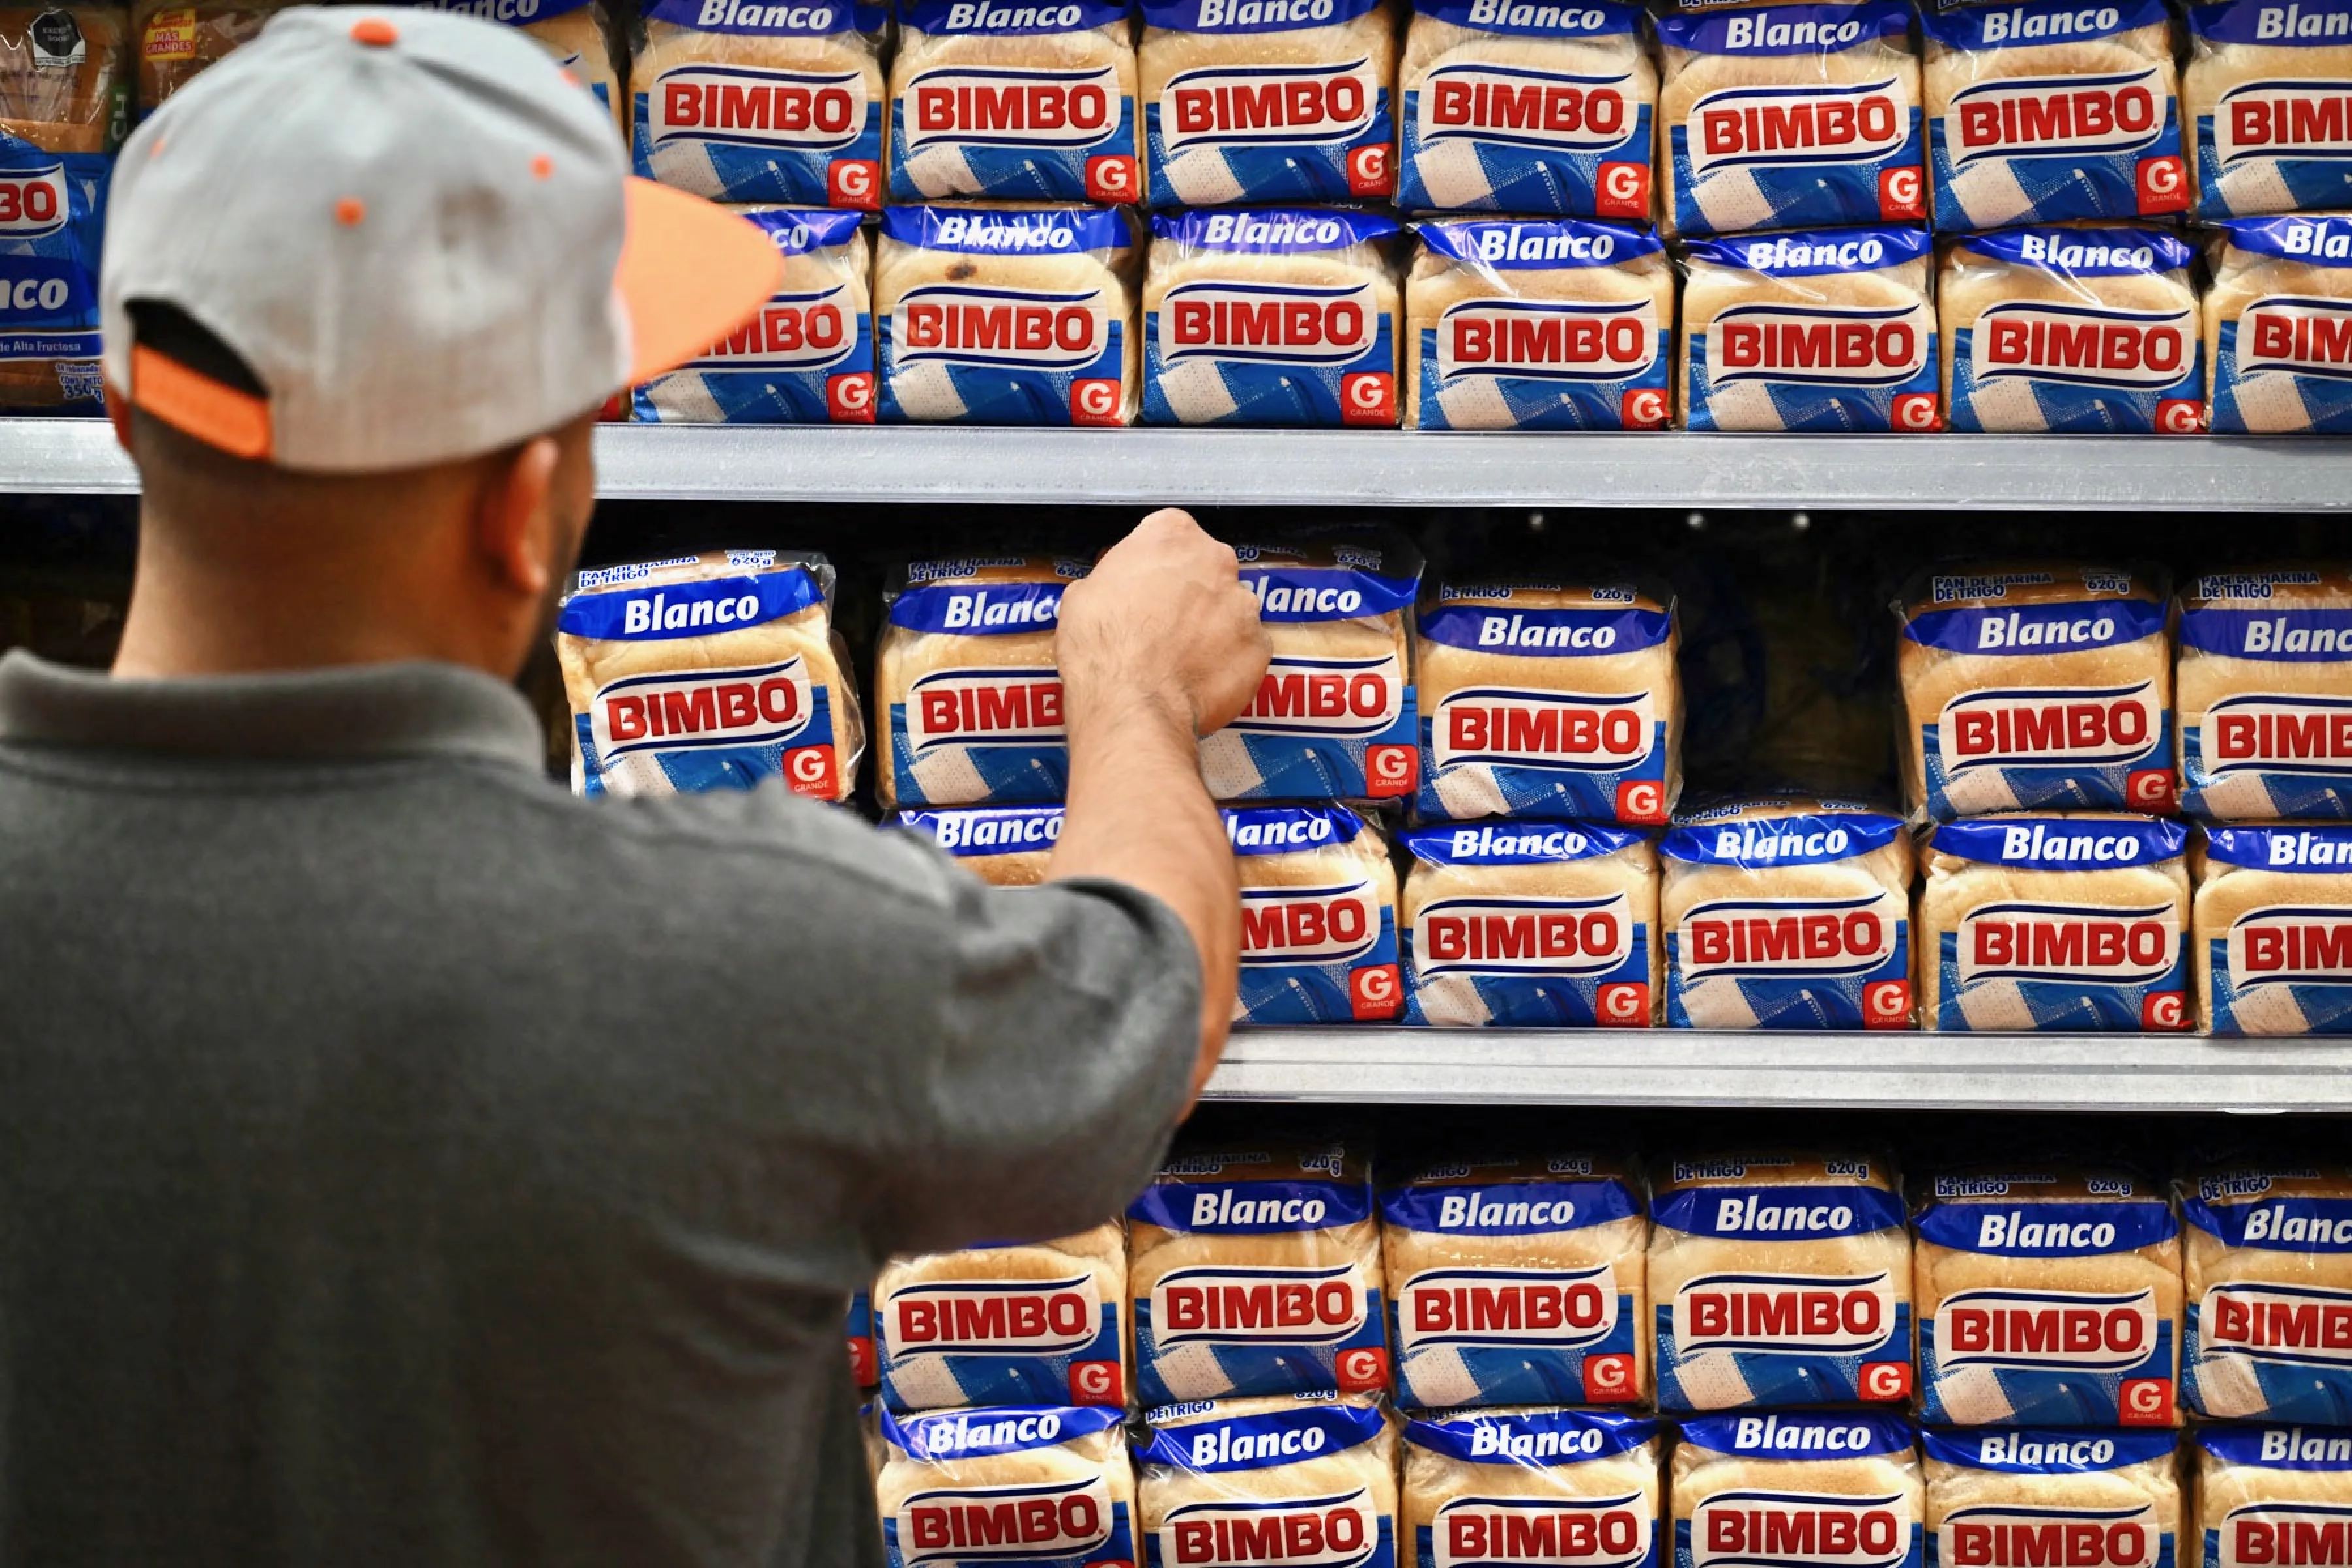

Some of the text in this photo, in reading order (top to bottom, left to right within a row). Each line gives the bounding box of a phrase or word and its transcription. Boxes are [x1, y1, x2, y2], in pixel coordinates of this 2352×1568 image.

[698, 0, 832, 30] Blanco
[946, 0, 1081, 29] Blanco
[1197, 0, 1333, 27] Blanco
[1468, 0, 1605, 31] Blanco
[1726, 12, 1860, 49] Blanco
[1982, 7, 2119, 43] Blanco
[2256, 3, 2352, 39] Blan
[146, 41, 192, 53] GRANDES
[665, 83, 853, 133] BIMBO
[918, 84, 1106, 130] BIMBO
[1176, 77, 1364, 133] BIMBO
[1433, 81, 1624, 133] BIMBO
[1960, 86, 2153, 146] BIMBO
[2232, 97, 2343, 144] BIM
[1704, 96, 1895, 154] BIMBO
[838, 163, 869, 196] G
[1096, 159, 1127, 189] G
[1356, 148, 1384, 179] G
[2147, 161, 2178, 192] G
[1607, 166, 1639, 199] G
[1889, 170, 1918, 203] G
[1604, 199, 1639, 208] GRANDE
[937, 216, 1074, 248] Blanco
[1203, 213, 1341, 244] Blanco
[1479, 229, 1614, 261] Blanco
[2284, 225, 2352, 256] Bla
[1747, 238, 1882, 270] Blanco
[2021, 234, 2155, 269] Blanco
[699, 304, 843, 357] MBO
[907, 304, 1093, 351] BIMBO
[1174, 301, 1363, 346] BIMBO
[1454, 318, 1644, 362] BIMBO
[2254, 314, 2352, 361] BIM
[13, 340, 81, 351] Alta Fructosa
[1723, 321, 1914, 367] BIMBO
[1989, 319, 2182, 371] BIMBO
[838, 376, 869, 409] G
[1081, 382, 1113, 414] G
[1351, 376, 1384, 408] G
[1903, 397, 1934, 427] G
[2166, 402, 2196, 433] G
[928, 566, 977, 578] TRIGO
[1935, 573, 2053, 588] PAN DE HARINA
[2200, 575, 2232, 586] PAN
[2259, 572, 2319, 584] HARINA
[1935, 585, 2005, 602] DE TRIGO
[2201, 583, 2272, 598] DE TRIGO
[624, 593, 760, 634] Blanco
[944, 591, 1060, 628] Blanc
[1478, 615, 1616, 649] Blanco
[1978, 613, 2116, 649] Blanco
[2244, 617, 2352, 653] Blanc
[607, 677, 797, 740] BIMBO
[921, 683, 1065, 734] BIMB
[1240, 672, 1387, 717] MBO
[1450, 707, 1642, 754] BIMBO
[1955, 700, 2151, 755] BIMBO
[2217, 714, 2352, 759] BIM
[793, 750, 825, 781] G
[1376, 749, 1407, 779] G
[794, 780, 829, 792] GRANDE
[1627, 785, 1657, 815] G
[2137, 773, 2166, 800] G
[936, 816, 1064, 847] Blanco
[1226, 815, 1331, 845] lanco
[1451, 827, 1586, 858] Blanco
[1714, 828, 1848, 858] Blanco
[2002, 827, 2140, 861] Blanco
[2269, 832, 2352, 866] Blan
[1241, 898, 1367, 950] MBO
[1428, 912, 1618, 959] BIMBO
[1692, 911, 1882, 964] BIMBO
[1975, 921, 2166, 965] BIMBO
[2245, 924, 2352, 970] BIM
[1360, 970, 1392, 1000] G
[1607, 987, 1639, 1017] G
[1874, 984, 1903, 1015] G
[1697, 1164, 1745, 1178] TRIGO
[1936, 1181, 2008, 1196] DE TRIGO
[2202, 1177, 2270, 1200] DE TRIGO
[1192, 1189, 1326, 1226] Blanco
[1439, 1192, 1574, 1228] Blanco
[1716, 1196, 1852, 1231] Blanco
[2244, 1205, 2352, 1243] Blanc
[1978, 1211, 2115, 1247] Blanco
[899, 1293, 1086, 1341] BIMBO
[1167, 1281, 1354, 1328] BIMBO
[1414, 1283, 1603, 1331] BIMBO
[1690, 1290, 1880, 1335] BIMBO
[1952, 1309, 2143, 1352] BIMBO
[2215, 1296, 2352, 1348] BIMB
[1079, 1364, 1109, 1393] G
[1347, 1351, 1376, 1379] G
[1594, 1358, 1625, 1386] G
[1869, 1365, 1901, 1396] G
[1147, 1400, 1215, 1422] DE TRIGO
[2130, 1382, 2161, 1411] G
[929, 1414, 1060, 1453] Blanco
[1192, 1426, 1326, 1466] Blanco
[1471, 1424, 1603, 1456] Blanco
[1735, 1416, 1870, 1451] Blanco
[1980, 1432, 2115, 1465] Blanco
[2261, 1431, 2352, 1462] Blan
[912, 1495, 1099, 1548] BIMBO
[1177, 1507, 1365, 1563] BIMBO
[1448, 1511, 1637, 1557] BIMBO
[1707, 1510, 1897, 1554] BIMBO
[1954, 1522, 2146, 1566] BIMBO
[2235, 1520, 2352, 1564] BIM
